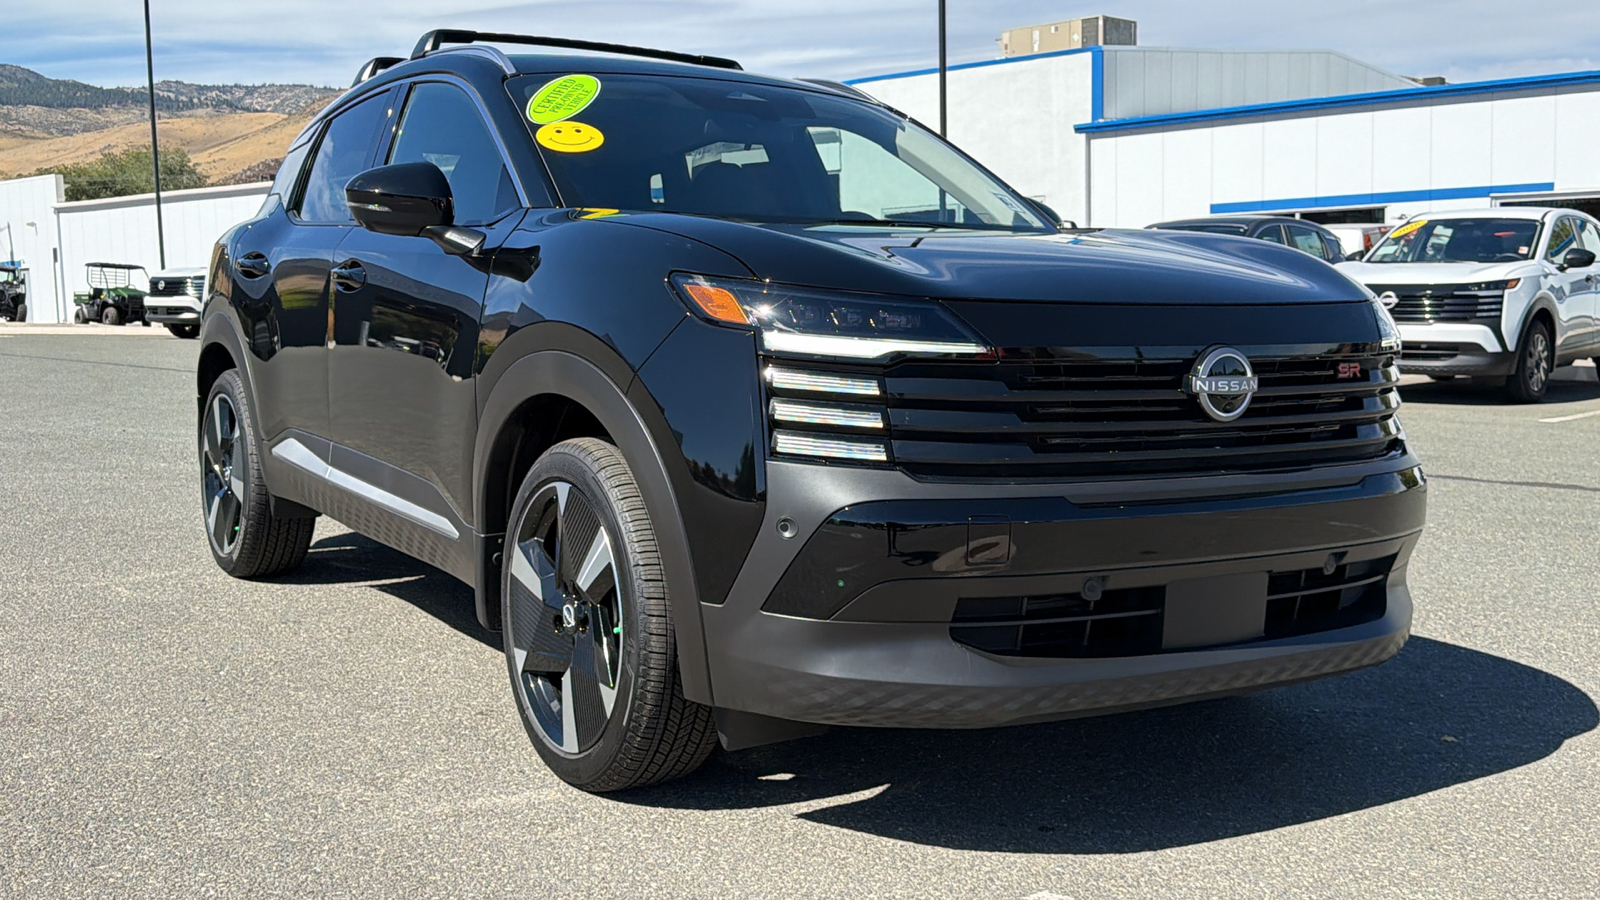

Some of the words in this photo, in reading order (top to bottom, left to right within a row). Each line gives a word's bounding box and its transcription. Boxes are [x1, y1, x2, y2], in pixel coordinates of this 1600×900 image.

[533, 79, 576, 114] CERTIFIED
[563, 89, 592, 111] VEHICLE
[1338, 362, 1361, 378] SR
[1196, 380, 1258, 391] NISSAN
